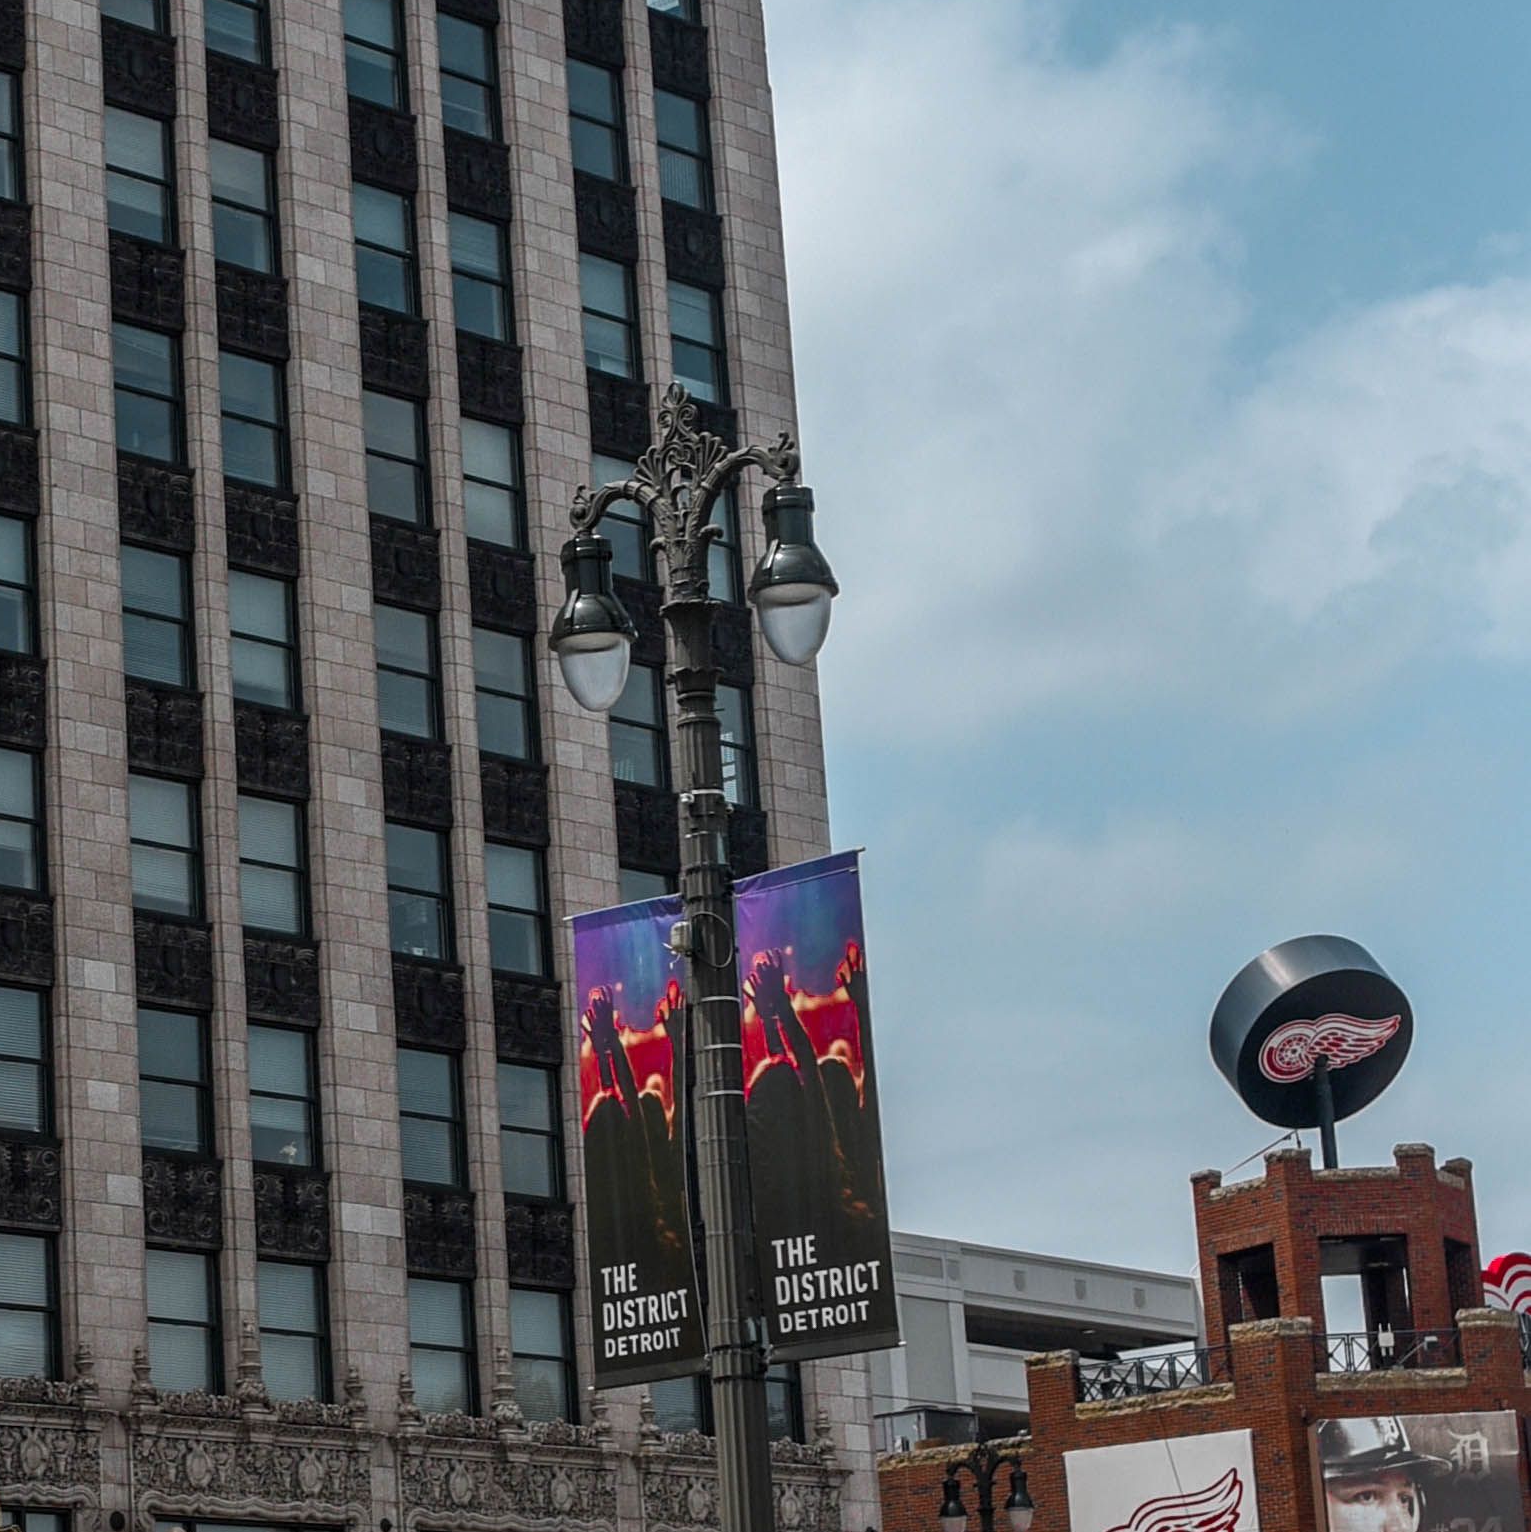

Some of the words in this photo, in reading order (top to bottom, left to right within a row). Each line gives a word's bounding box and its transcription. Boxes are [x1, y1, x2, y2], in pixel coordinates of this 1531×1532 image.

[771, 1235, 817, 1268] THE
[601, 1263, 638, 1296] THE
[774, 1260, 880, 1306] DISTRICT
[602, 1289, 688, 1332] DISTRICT
[779, 1301, 870, 1334] DETROIT
[604, 1327, 681, 1359] DETROIT
